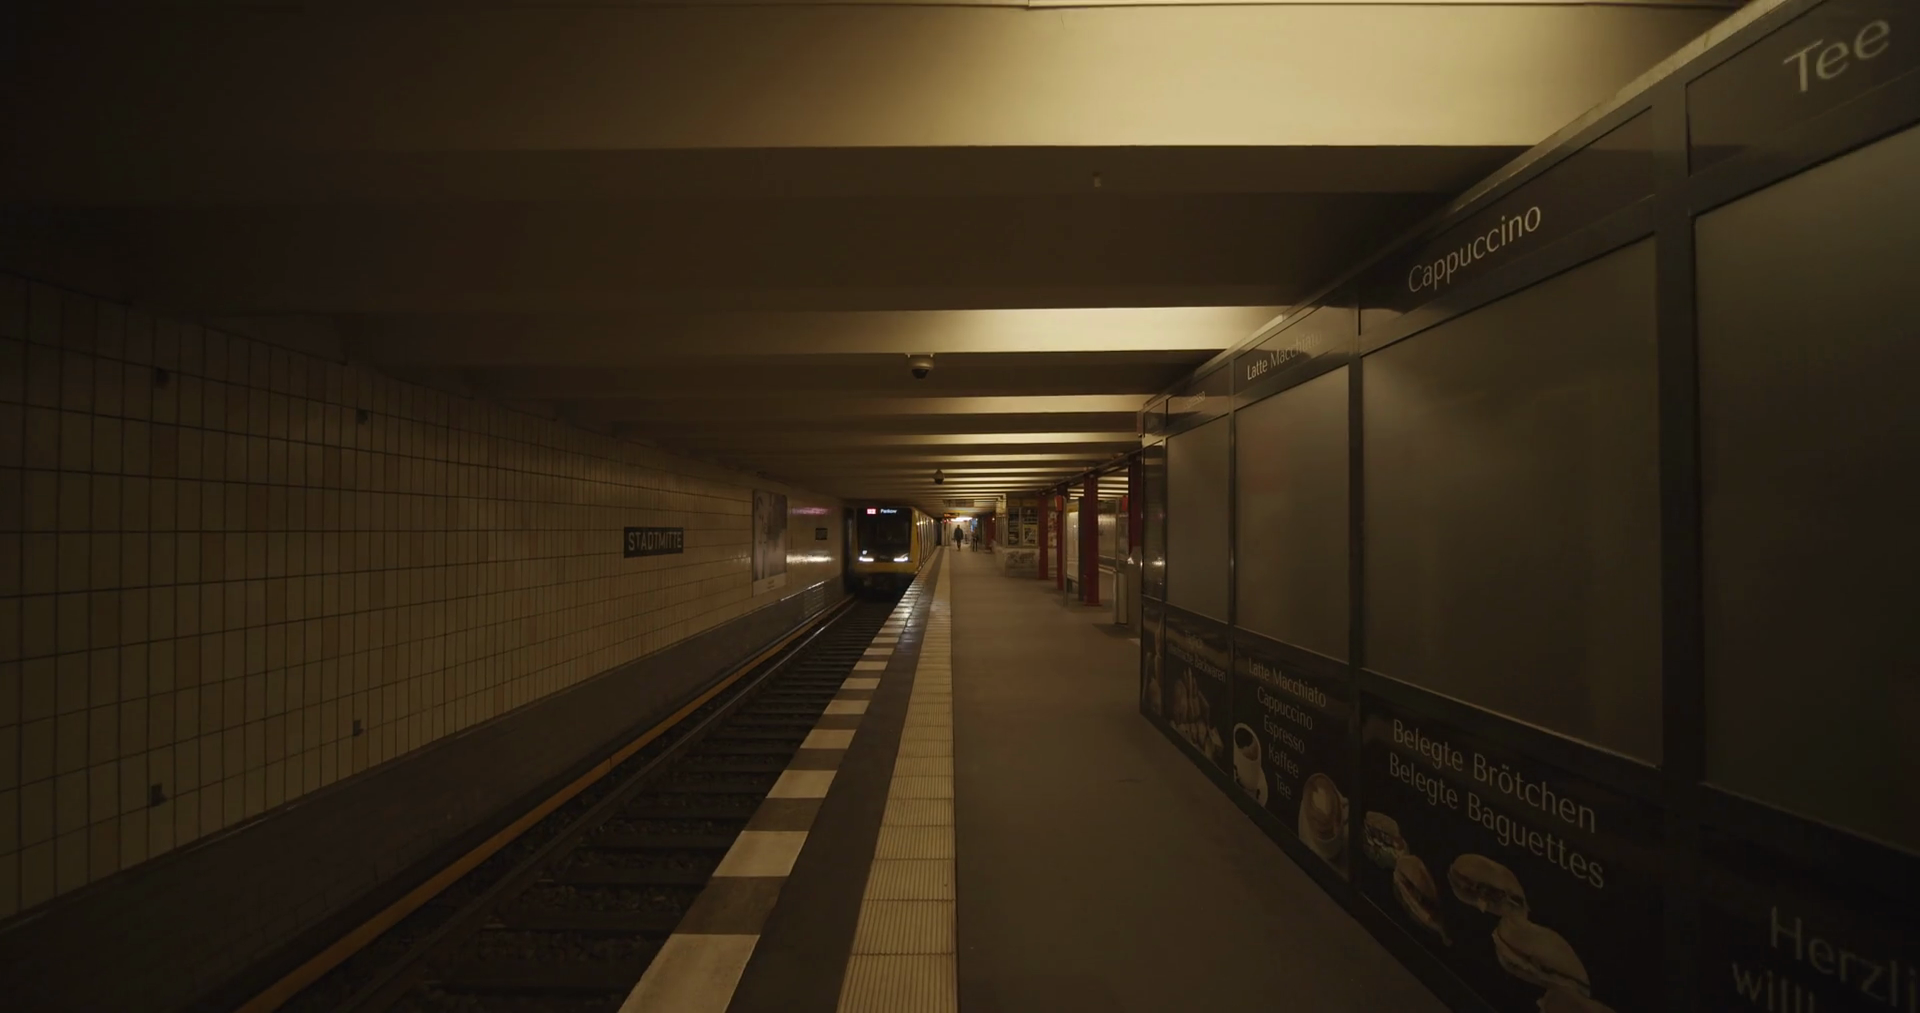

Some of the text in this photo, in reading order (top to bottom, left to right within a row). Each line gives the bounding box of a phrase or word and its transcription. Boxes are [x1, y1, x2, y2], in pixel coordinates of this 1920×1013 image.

[1782, 18, 1890, 93] Tee
[1408, 206, 1542, 293] Cappuccino
[1246, 358, 1268, 381] Latte
[628, 531, 682, 551] STADTMITTE
[1248, 657, 1327, 708] Latte Macchiato
[1257, 686, 1313, 731] Cappuccino
[1263, 714, 1305, 754] Espresso
[1268, 743, 1299, 779] Kaffee
[1393, 718, 1595, 834] Belegte Brötchen
[1275, 773, 1292, 800] Tee
[1389, 751, 1604, 889] Belegte Baguettes
